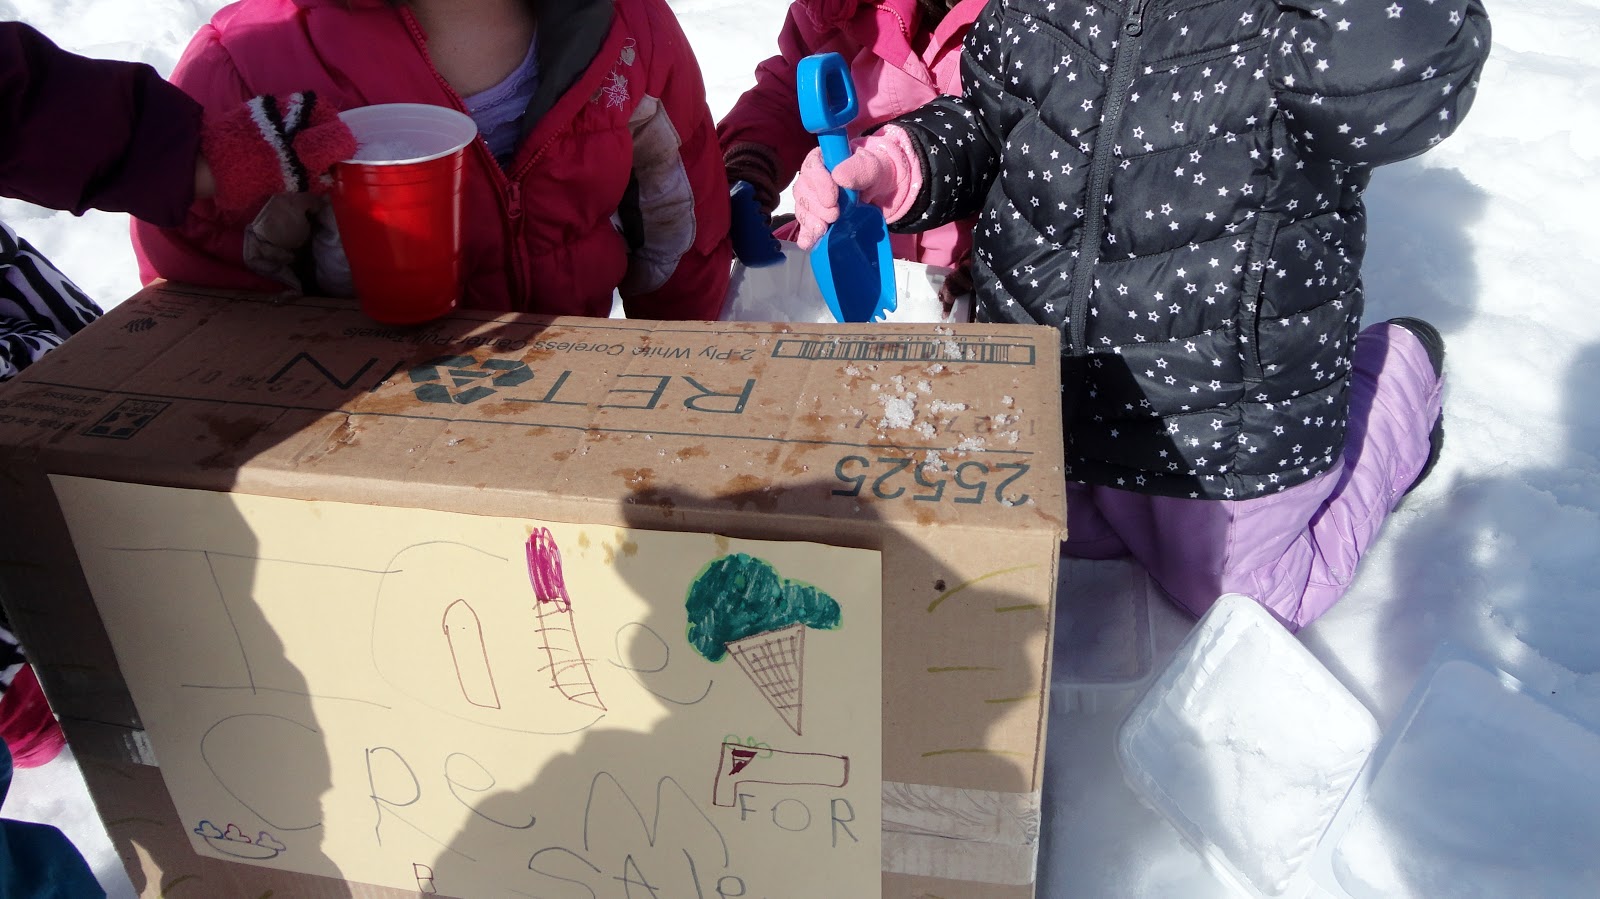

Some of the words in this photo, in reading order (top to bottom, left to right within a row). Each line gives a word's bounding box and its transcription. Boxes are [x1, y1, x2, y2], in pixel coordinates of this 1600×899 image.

[534, 340, 625, 356] Coreless
[632, 345, 691, 359] White
[699, 345, 756, 361] 2-Ply
[831, 455, 1031, 507] 25525
[738, 793, 859, 849] FOR
